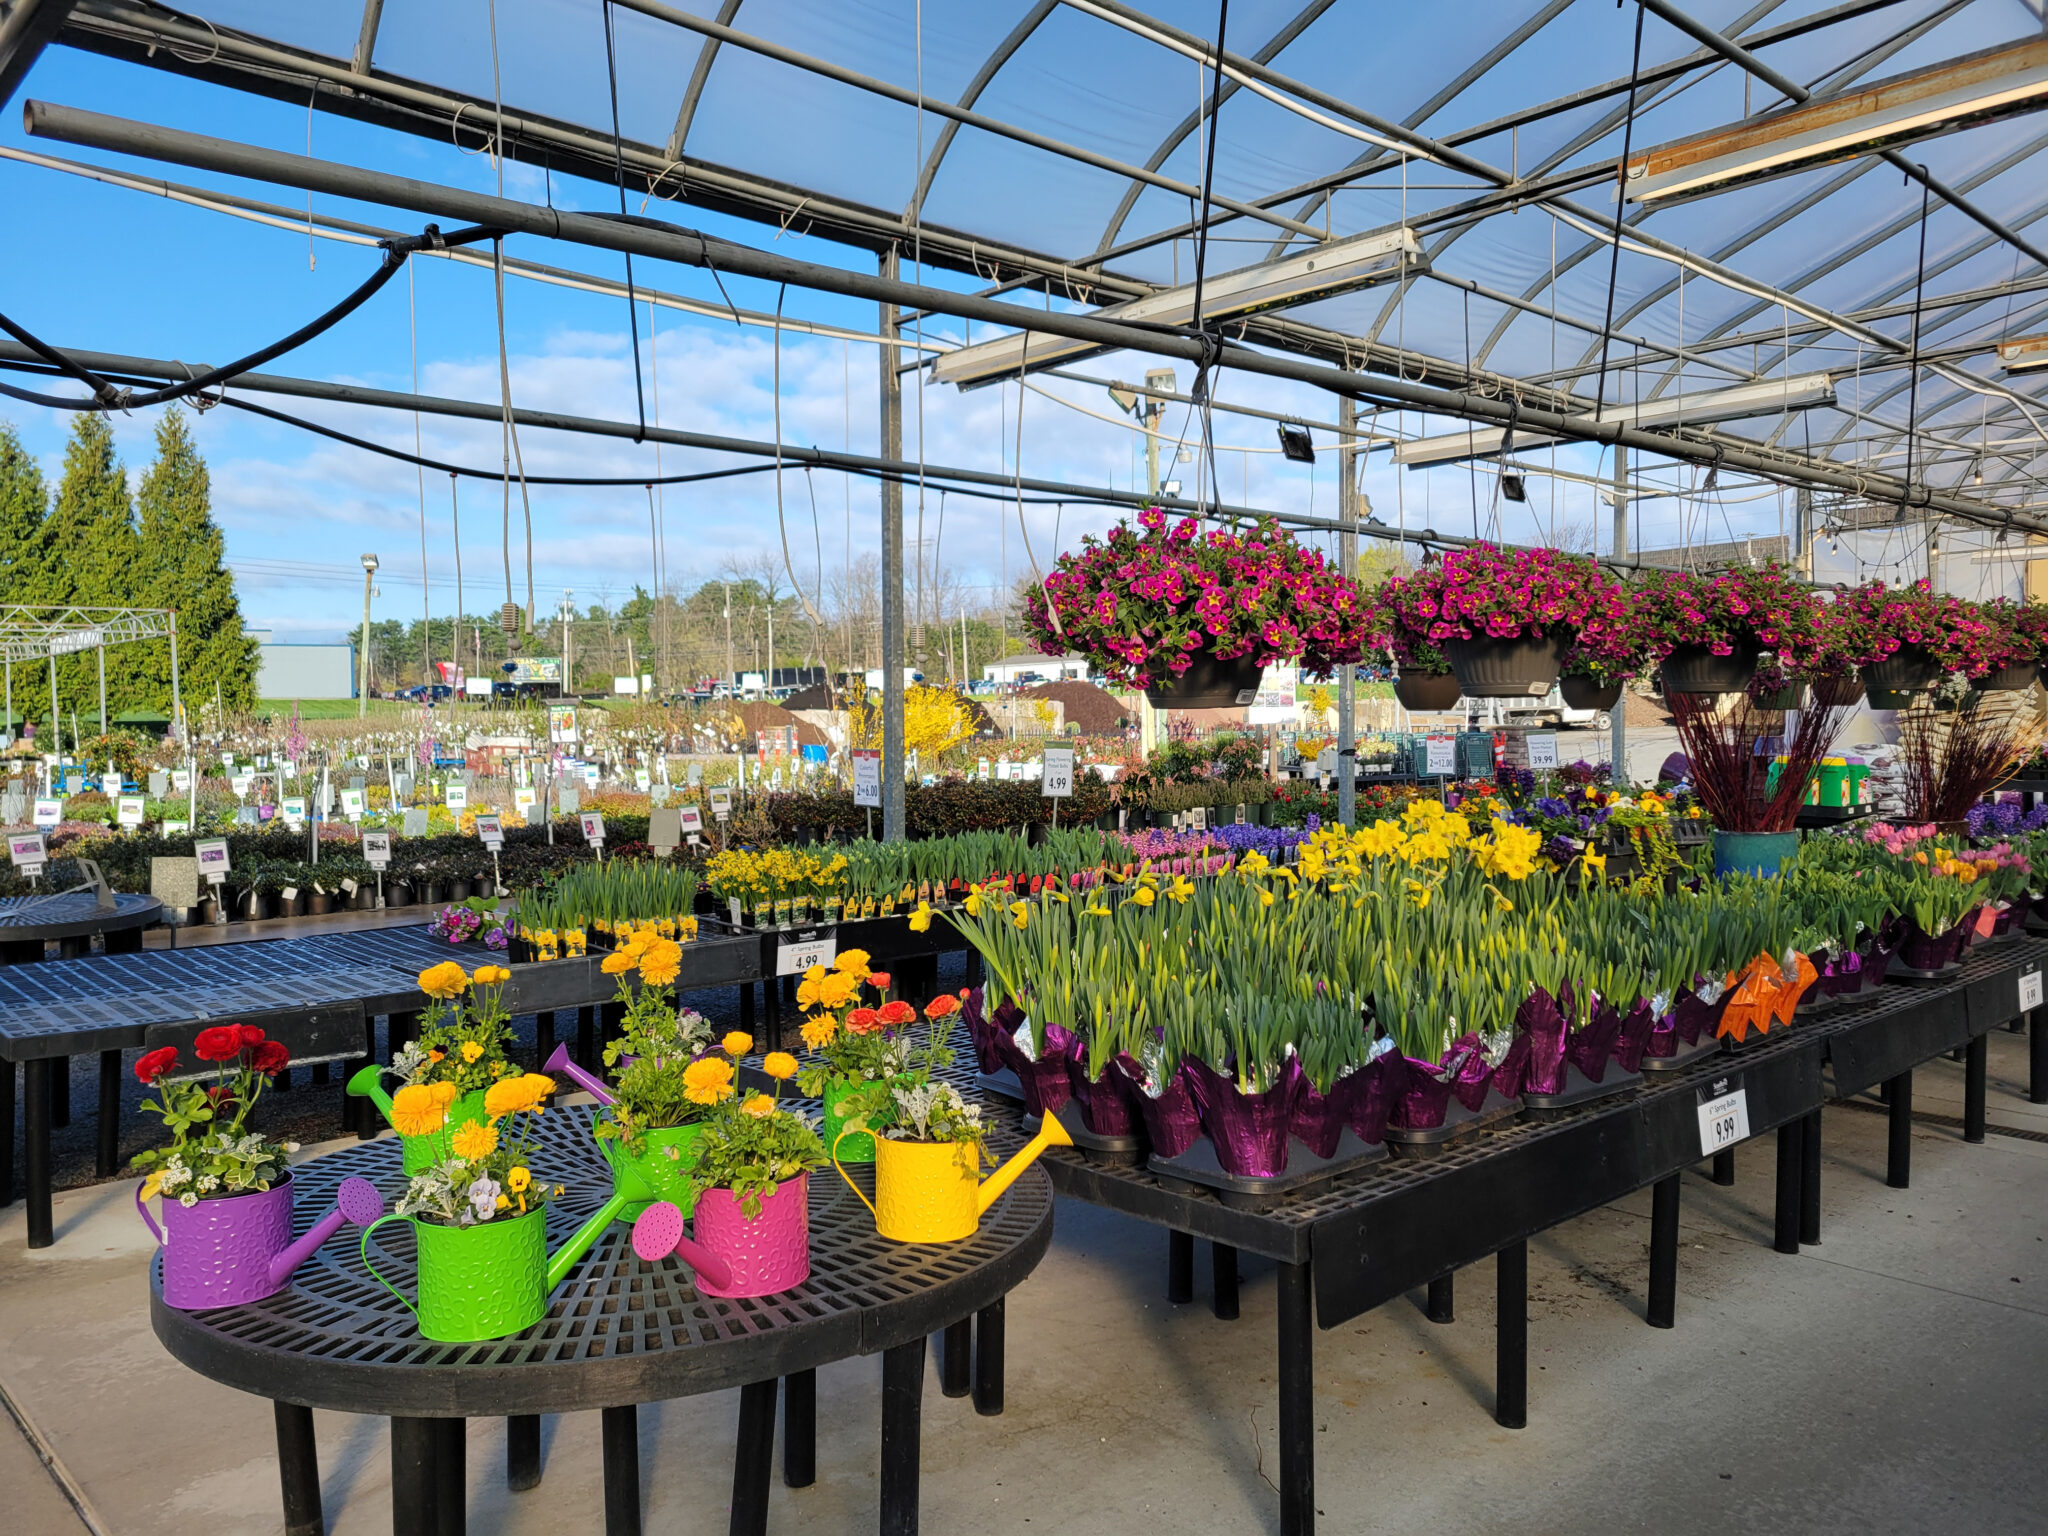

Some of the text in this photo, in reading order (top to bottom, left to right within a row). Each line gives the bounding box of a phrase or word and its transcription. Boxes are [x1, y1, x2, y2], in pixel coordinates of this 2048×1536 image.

[1533, 755, 1553, 764] 39.99
[1049, 777, 1067, 789] 4.99
[856, 784, 861, 796] 2
[865, 785, 878, 797] 6.00
[796, 954, 818, 969] 4.99
[1716, 1116, 1734, 1143] 9.99
